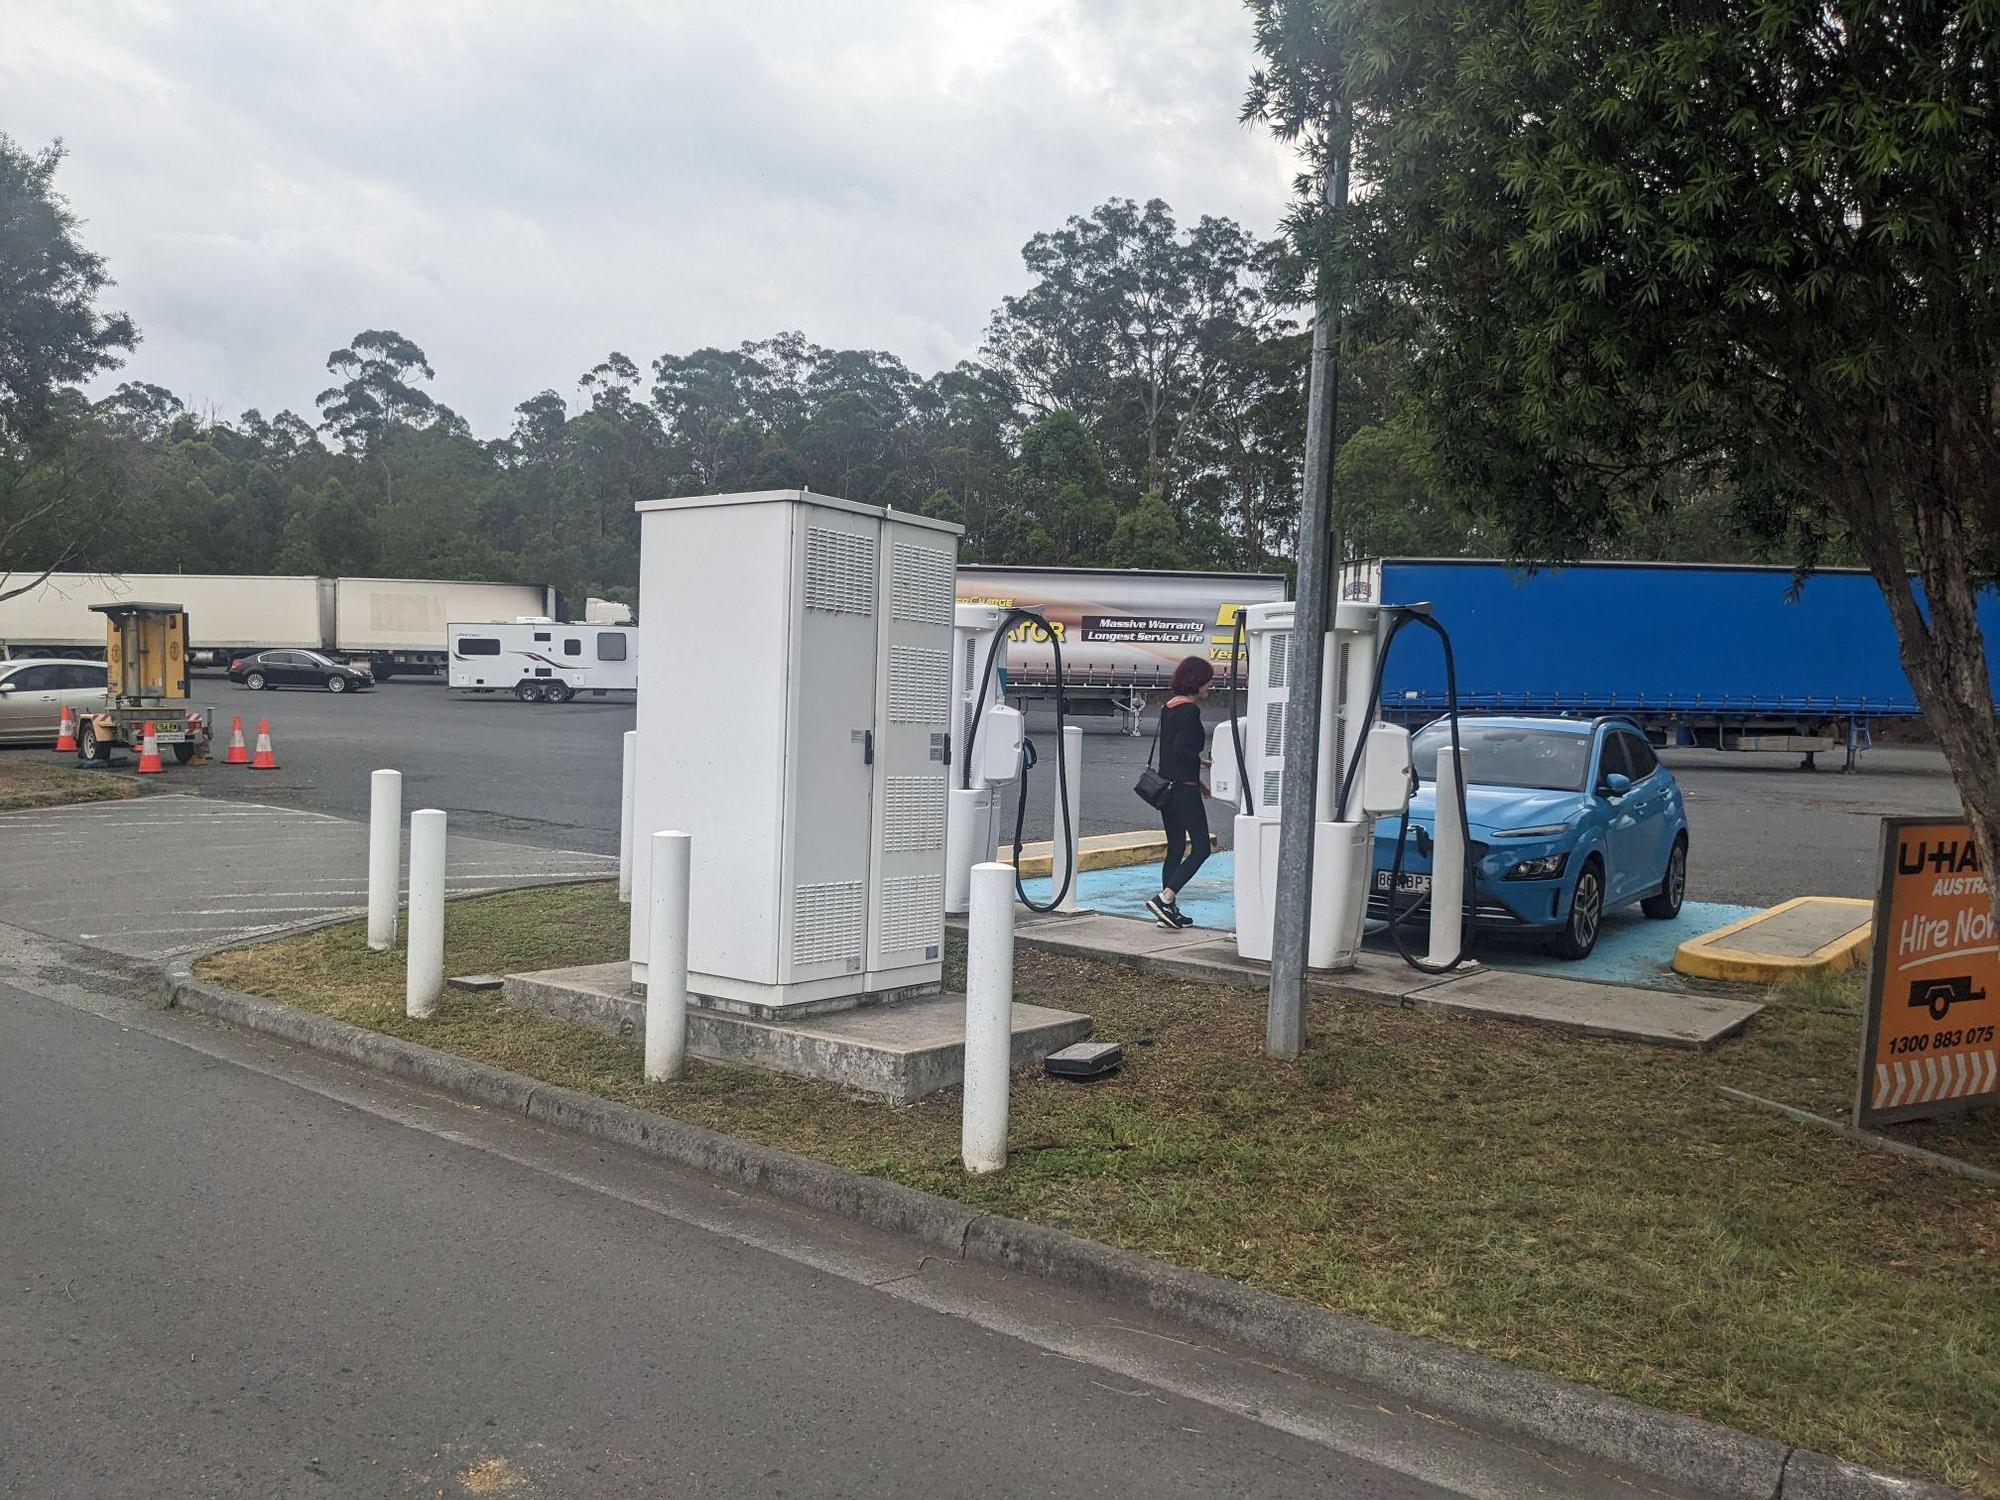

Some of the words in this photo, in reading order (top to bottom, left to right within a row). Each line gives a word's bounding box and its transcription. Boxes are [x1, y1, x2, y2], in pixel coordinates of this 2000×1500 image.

[1087, 631, 1136, 643] Longest
[1137, 632, 1179, 642] Service
[1180, 633, 1204, 643] Life
[1099, 618, 1147, 629] Massive
[1149, 620, 1204, 632] Warranty
[1899, 841, 1983, 875] U-HA
[1899, 914, 1949, 956] Hire
[1889, 1034, 1929, 1055] 1300
[1932, 1030, 1963, 1049] 883
[1965, 1025, 1995, 1044] 075
